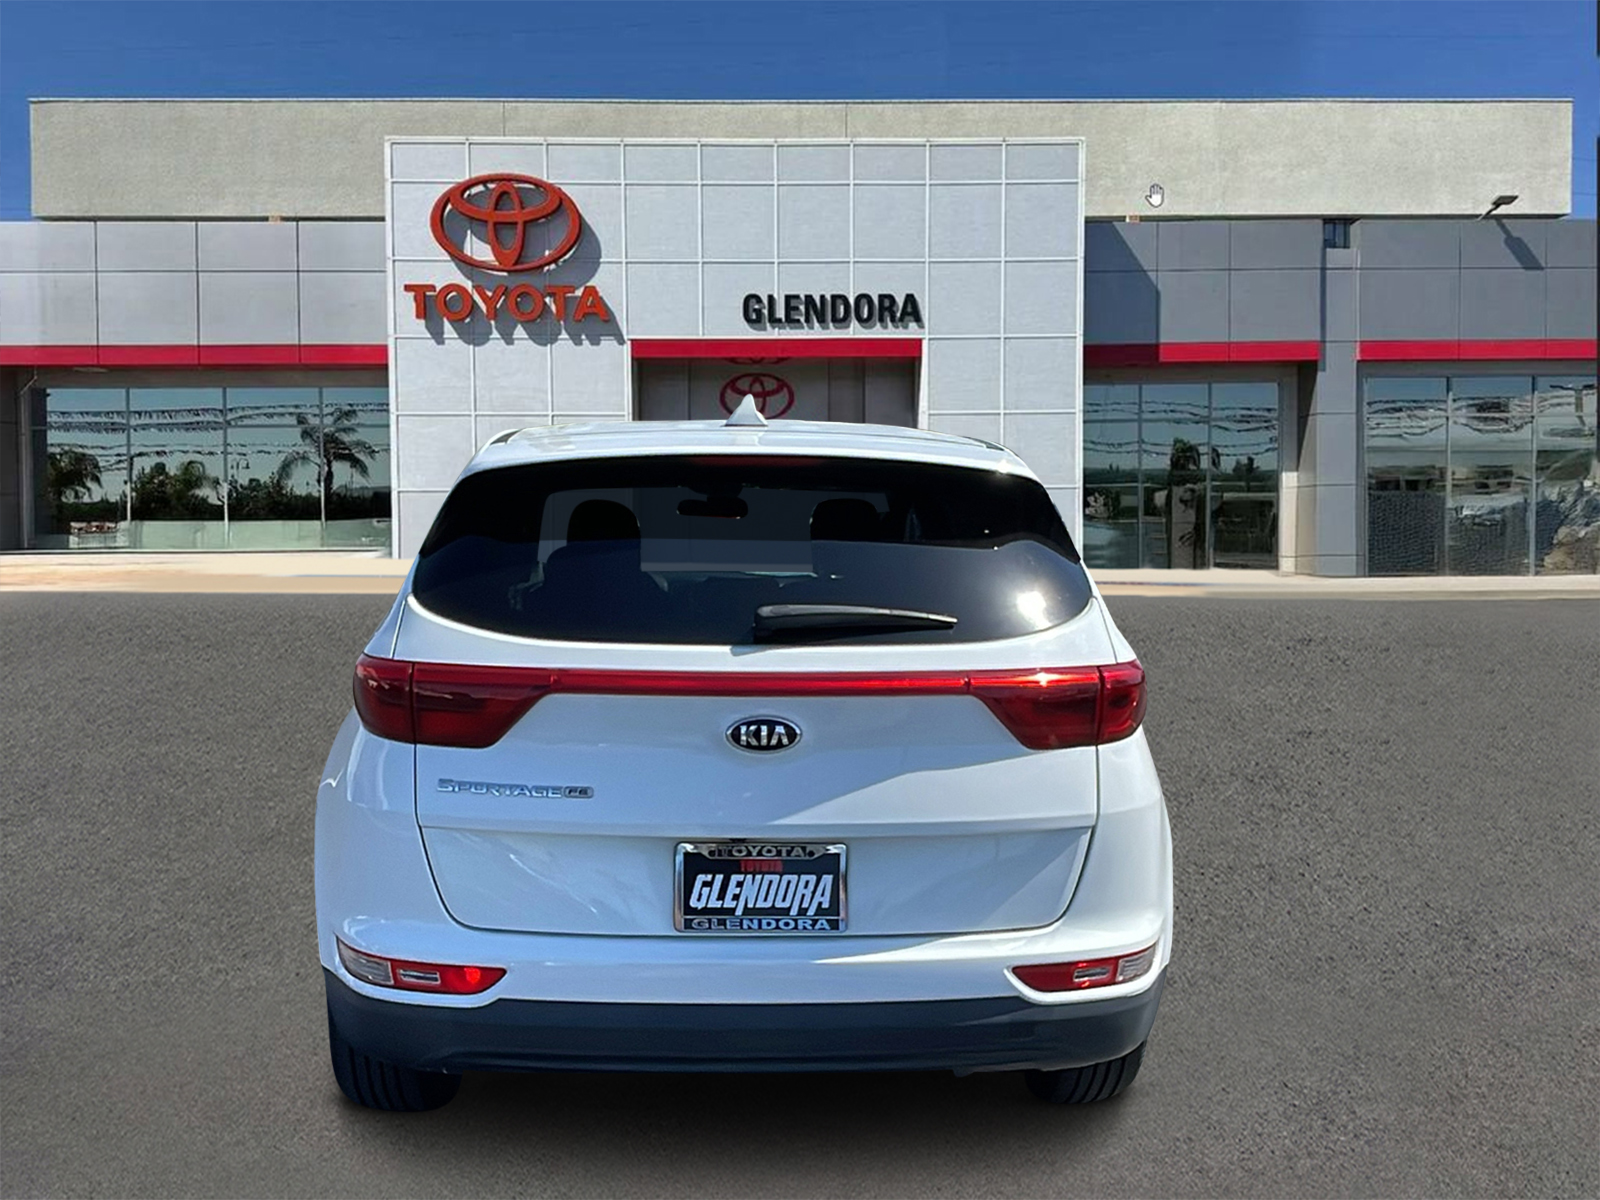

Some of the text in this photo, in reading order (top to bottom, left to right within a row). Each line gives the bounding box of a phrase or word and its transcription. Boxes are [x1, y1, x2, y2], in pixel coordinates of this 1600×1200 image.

[404, 284, 609, 322] TOYOTA
[743, 293, 922, 325] GLENDORA
[740, 725, 789, 746] KIA
[437, 778, 562, 798] SPORTAGE
[716, 845, 805, 858] TOYOTA
[689, 874, 834, 916] GLENDORA
[691, 918, 831, 930] GLENDORA
